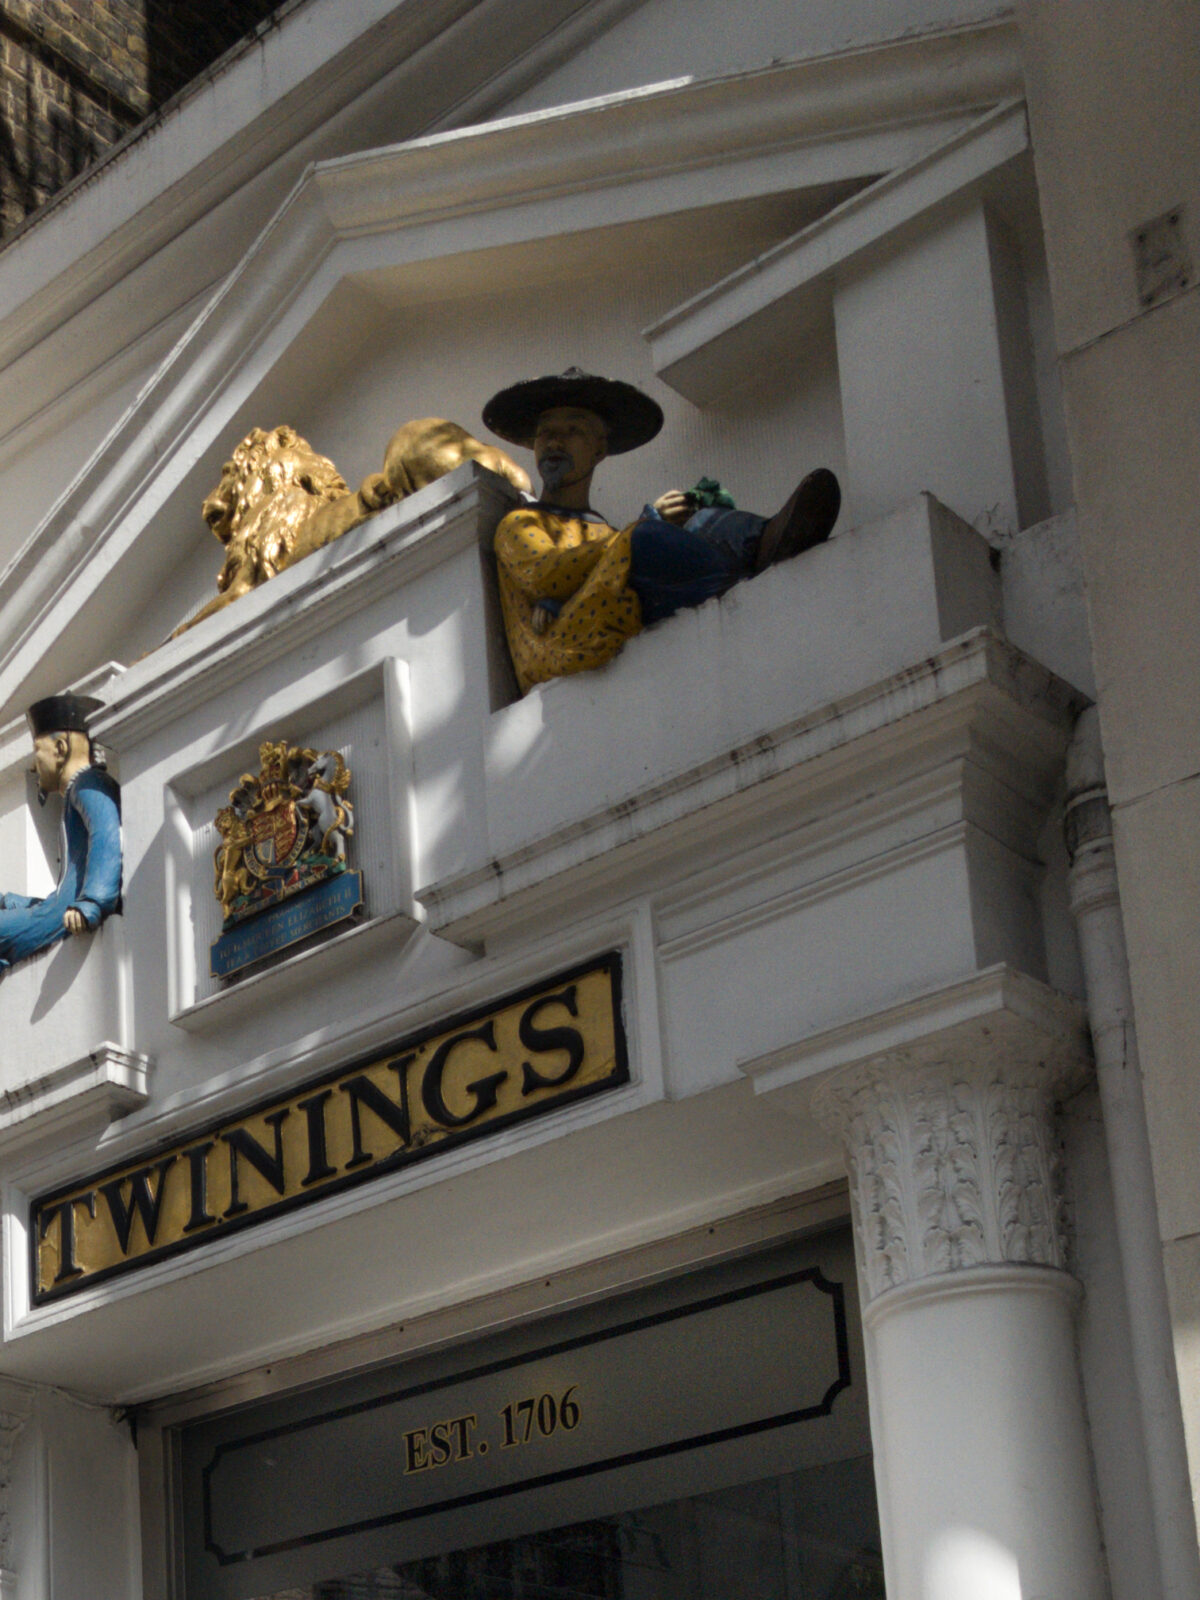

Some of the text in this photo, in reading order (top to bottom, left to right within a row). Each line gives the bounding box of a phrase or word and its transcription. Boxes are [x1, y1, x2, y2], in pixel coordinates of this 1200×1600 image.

[40, 984, 585, 1283] TWININGS
[402, 1383, 580, 1475] EST. 1706
